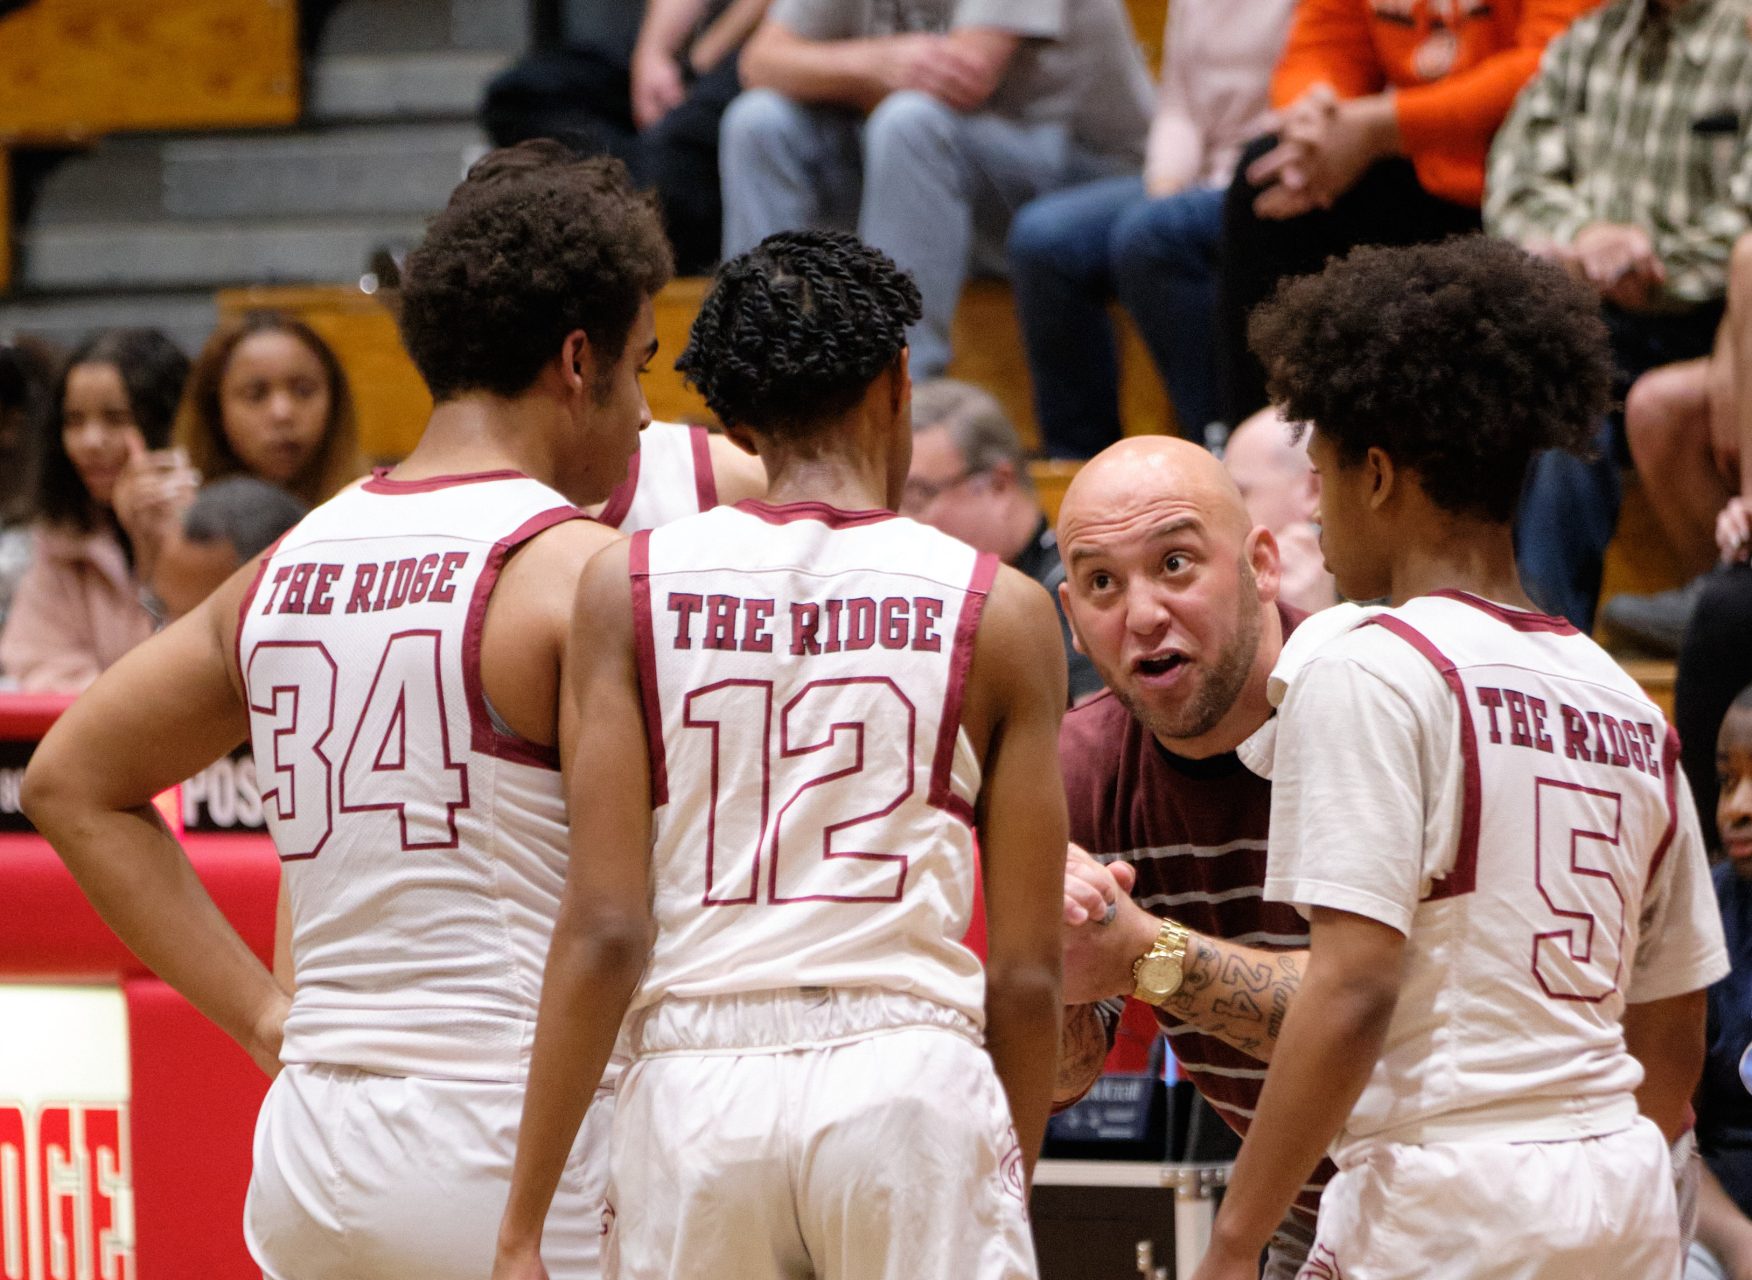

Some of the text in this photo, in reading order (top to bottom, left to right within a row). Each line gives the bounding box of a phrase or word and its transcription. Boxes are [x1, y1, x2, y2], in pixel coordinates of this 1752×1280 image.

[262, 551, 469, 615] THE RIDGE
[667, 592, 943, 656] THE RIDGE
[247, 629, 470, 862] 34
[1476, 686, 1660, 779] THE RIDGE
[683, 676, 916, 907] 12
[1531, 776, 1625, 1003] 5
[1211, 954, 1272, 1023] 24
